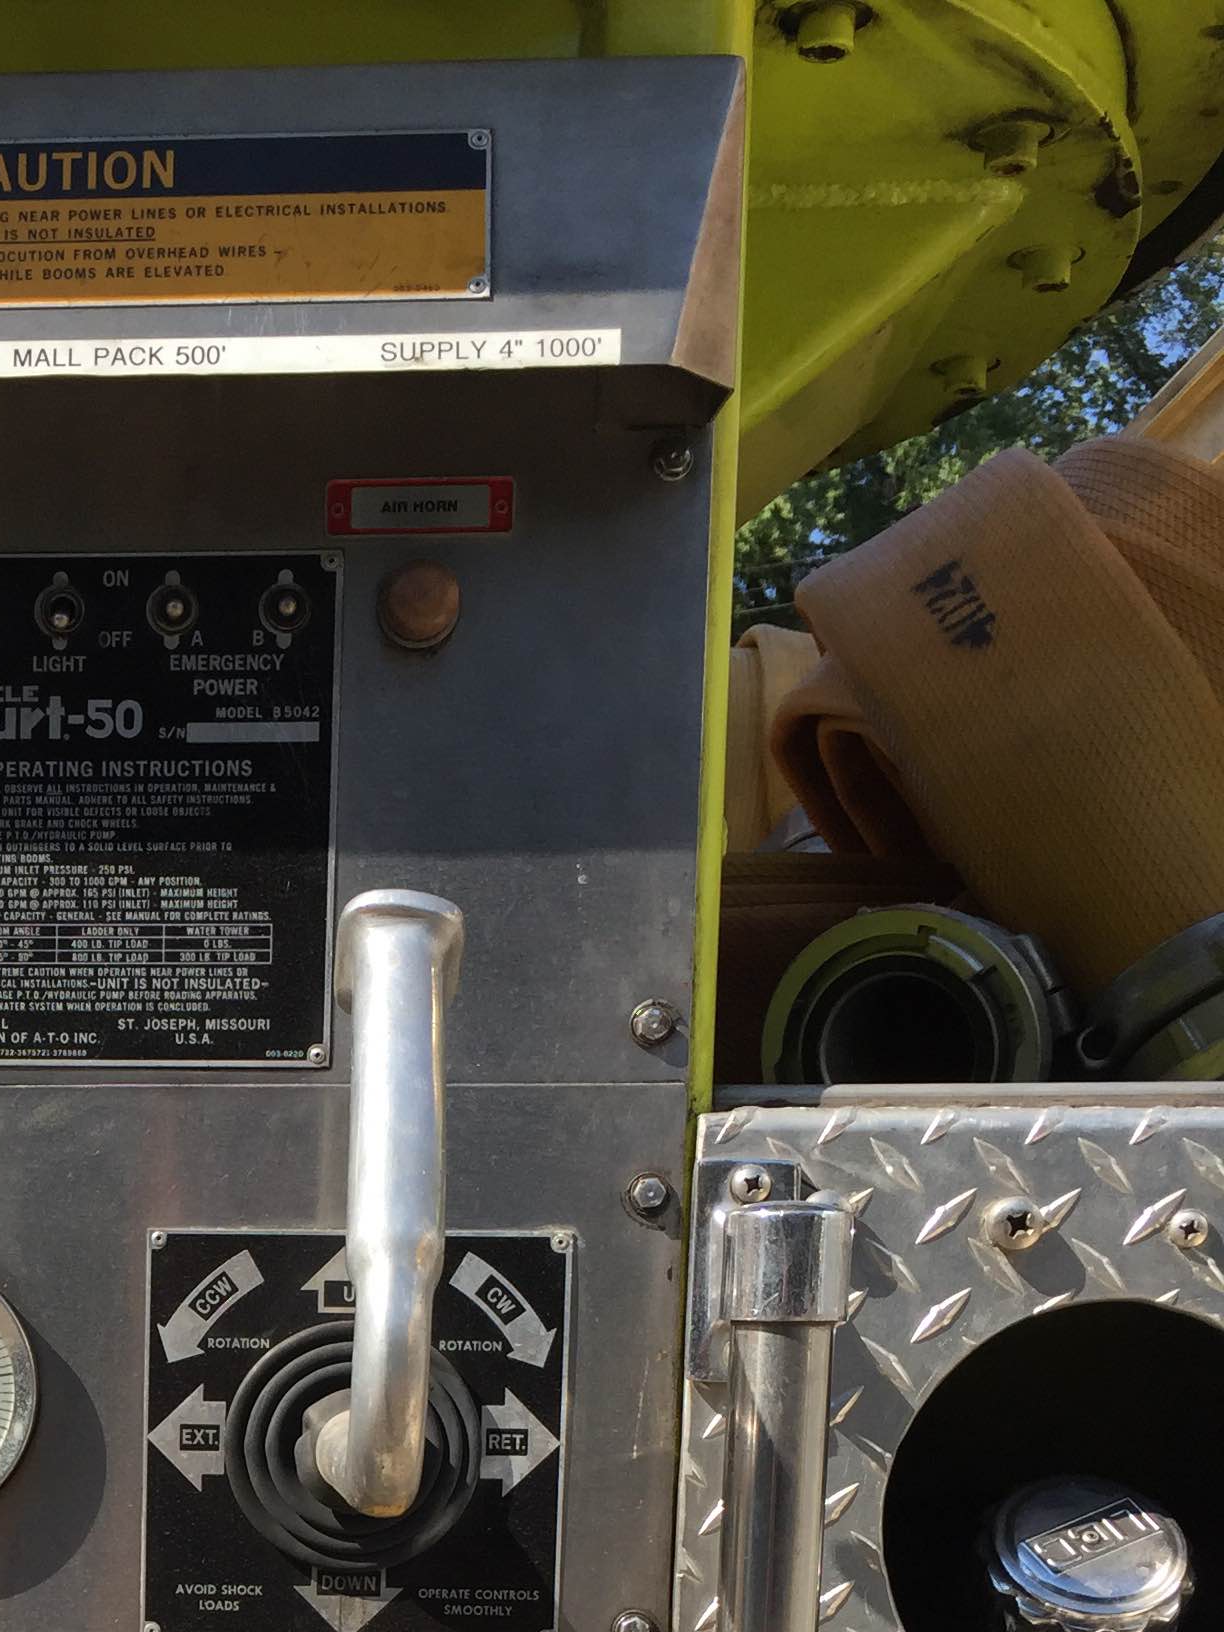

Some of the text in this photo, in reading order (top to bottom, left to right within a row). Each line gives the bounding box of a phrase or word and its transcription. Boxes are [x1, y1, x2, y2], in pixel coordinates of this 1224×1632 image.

[18, 209, 60, 224] NEAR
[67, 208, 123, 223] POWER
[130, 207, 177, 222] LINES
[185, 206, 207, 220] OR
[215, 204, 312, 220] ELECTRICAL
[319, 201, 446, 218] INSTALLATIONS
[3, 227, 19, 242] IS
[27, 226, 59, 242] NOT
[67, 225, 156, 241] INSULATED
[13, 344, 226, 369] MALL PACK 500'
[380, 337, 602, 362] SUPPLY 4" 1000'
[381, 499, 458, 514] AIR HORN
[102, 569, 130, 588] ON
[98, 630, 133, 649] OFF
[190, 630, 205, 648] A
[252, 630, 265, 648] B
[32, 655, 87, 673] LIGHT
[169, 653, 285, 672] EMERGENCY
[193, 678, 258, 698] POWER
[158, 725, 187, 741] S/N
[101, 759, 253, 778] INSTRUCTIONS
[117, 1018, 270, 1031] ST. JOSEPH, MISSOURI
[10, 1032, 29, 1044] OF
[73, 1032, 101, 1044] INC.
[175, 1032, 214, 1045] U.S.A.
[194, 1275, 237, 1317] CCW
[484, 1286, 517, 1316] CW
[206, 1336, 271, 1350] ROTATION
[438, 1339, 503, 1352] ROTATION
[181, 1428, 220, 1447] EXT.
[487, 1432, 527, 1452] RET.
[175, 1584, 263, 1596] AVOID SHOCK
[320, 1573, 378, 1593] DOWN
[418, 1588, 540, 1601] OPERATE CONTROLS
[199, 1599, 240, 1611] LOADS
[443, 1604, 513, 1616] SMOOTHLY
